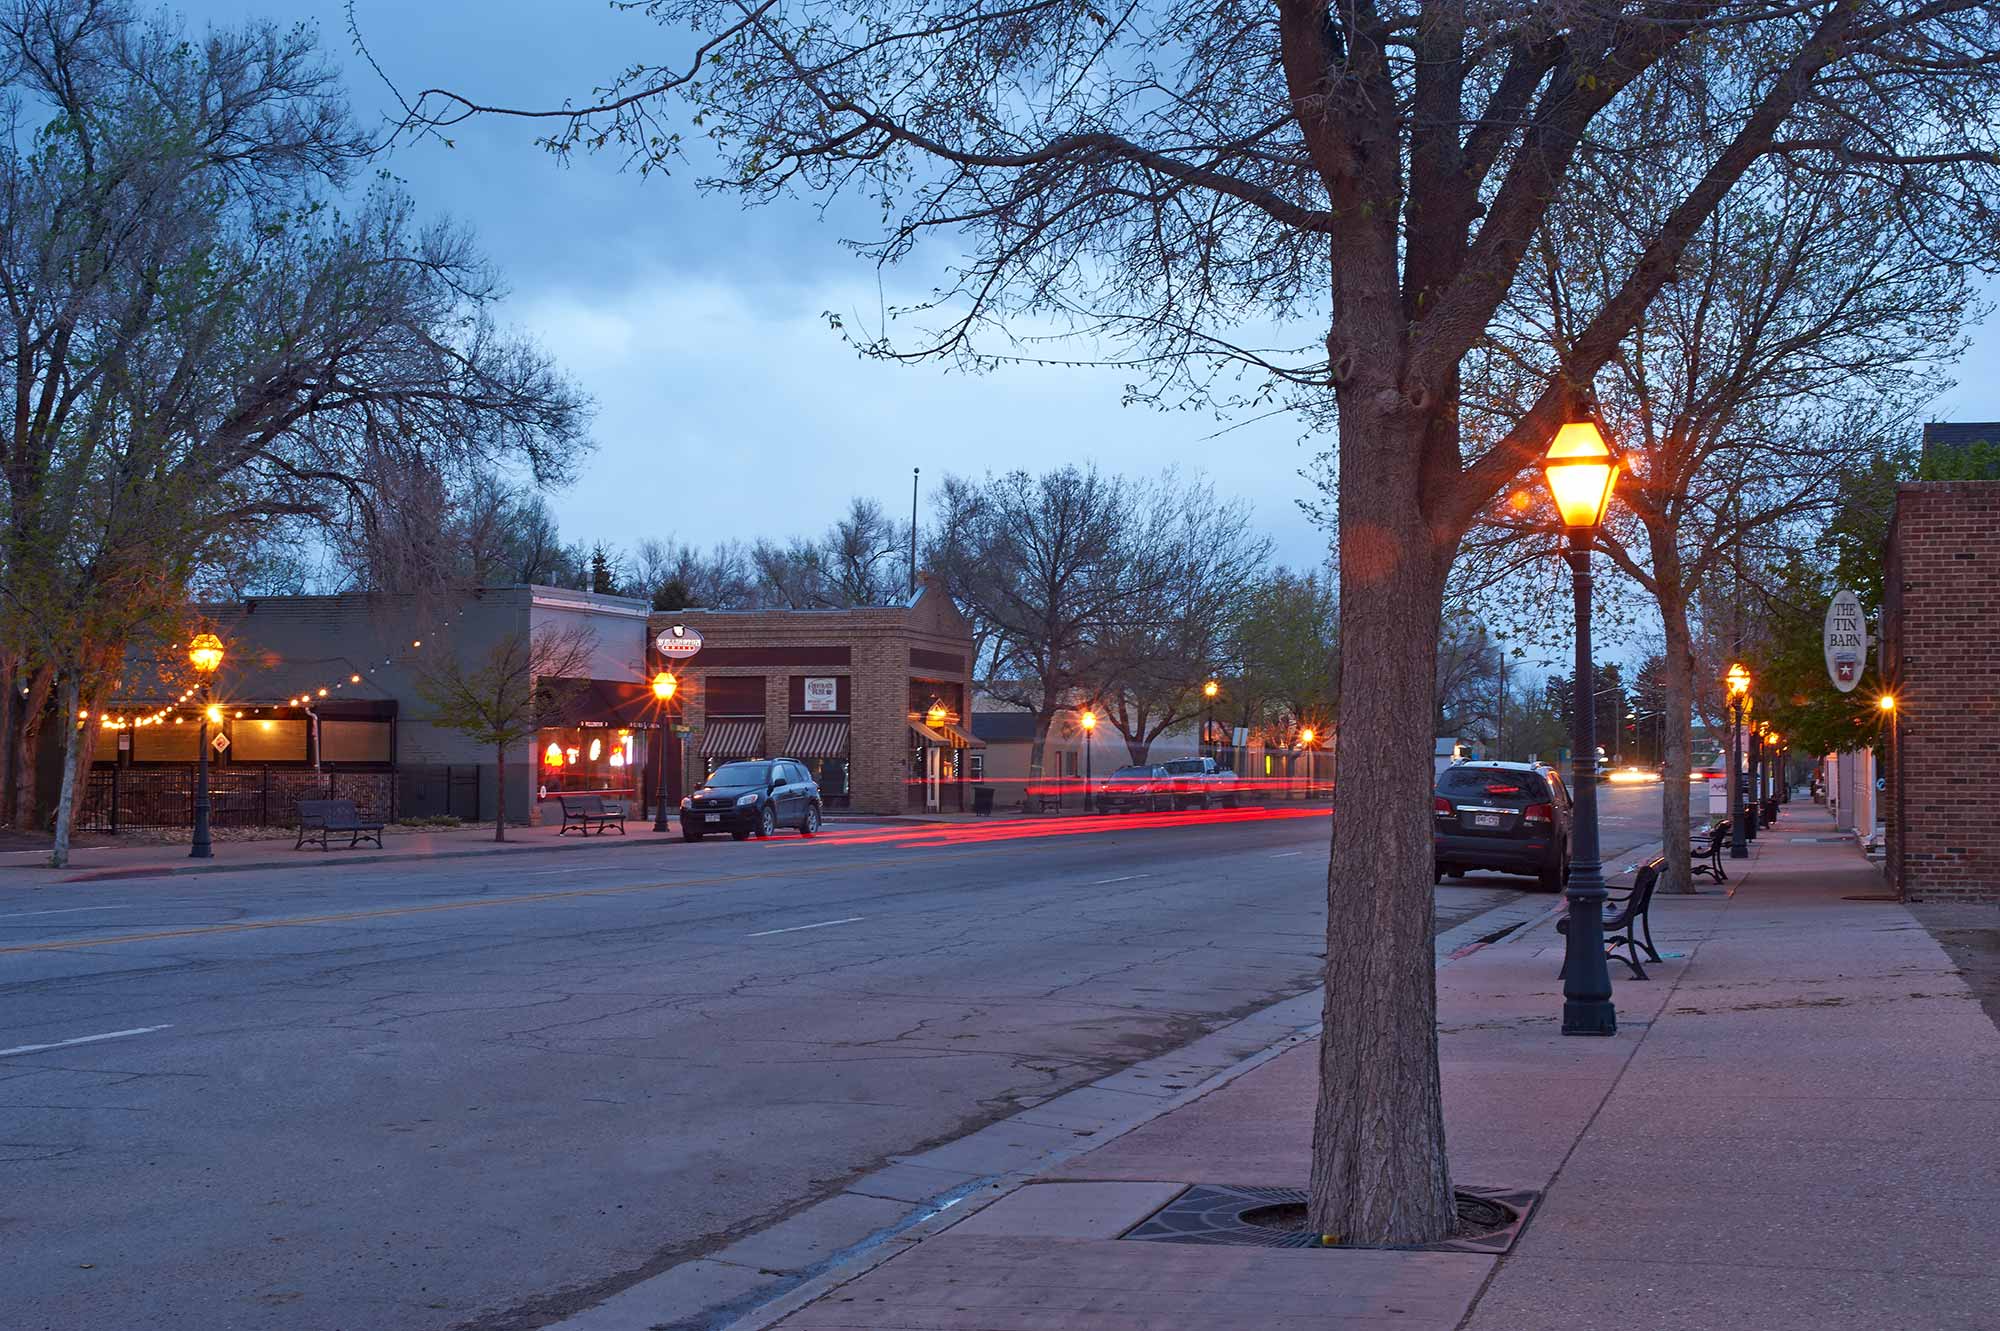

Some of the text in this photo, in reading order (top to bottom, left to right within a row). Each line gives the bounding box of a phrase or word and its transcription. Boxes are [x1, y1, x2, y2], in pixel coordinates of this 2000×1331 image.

[1835, 603, 1855, 616] THE
[1833, 618, 1857, 631] TIN
[1829, 634, 1861, 647] BARN
